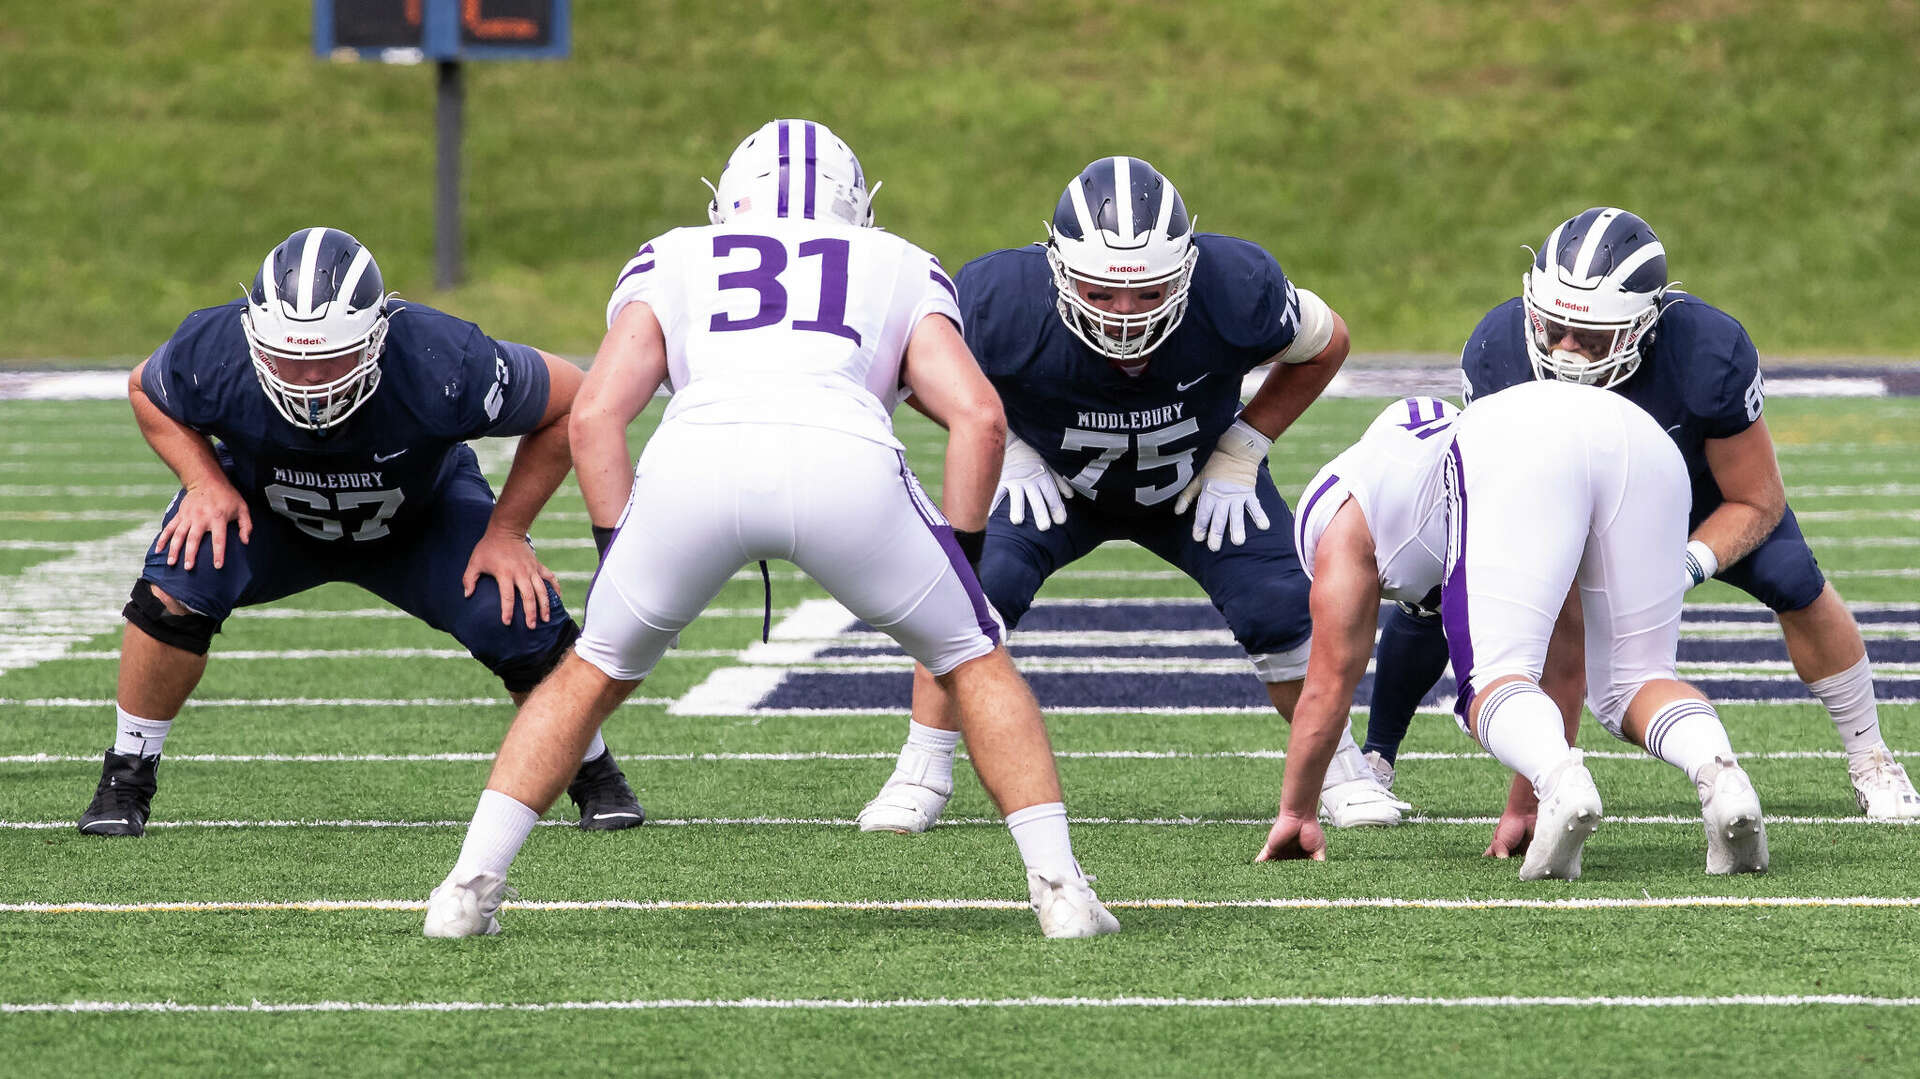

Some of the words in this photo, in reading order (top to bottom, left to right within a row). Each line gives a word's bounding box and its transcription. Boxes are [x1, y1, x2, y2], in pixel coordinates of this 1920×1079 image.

[709, 234, 862, 348] 31
[1555, 298, 1589, 313] Riddell
[1077, 402, 1184, 429] MIDDLEBURY
[273, 467, 384, 489] MIDDLEBURY
[1061, 416, 1200, 506] 75
[264, 483, 405, 541] 67
